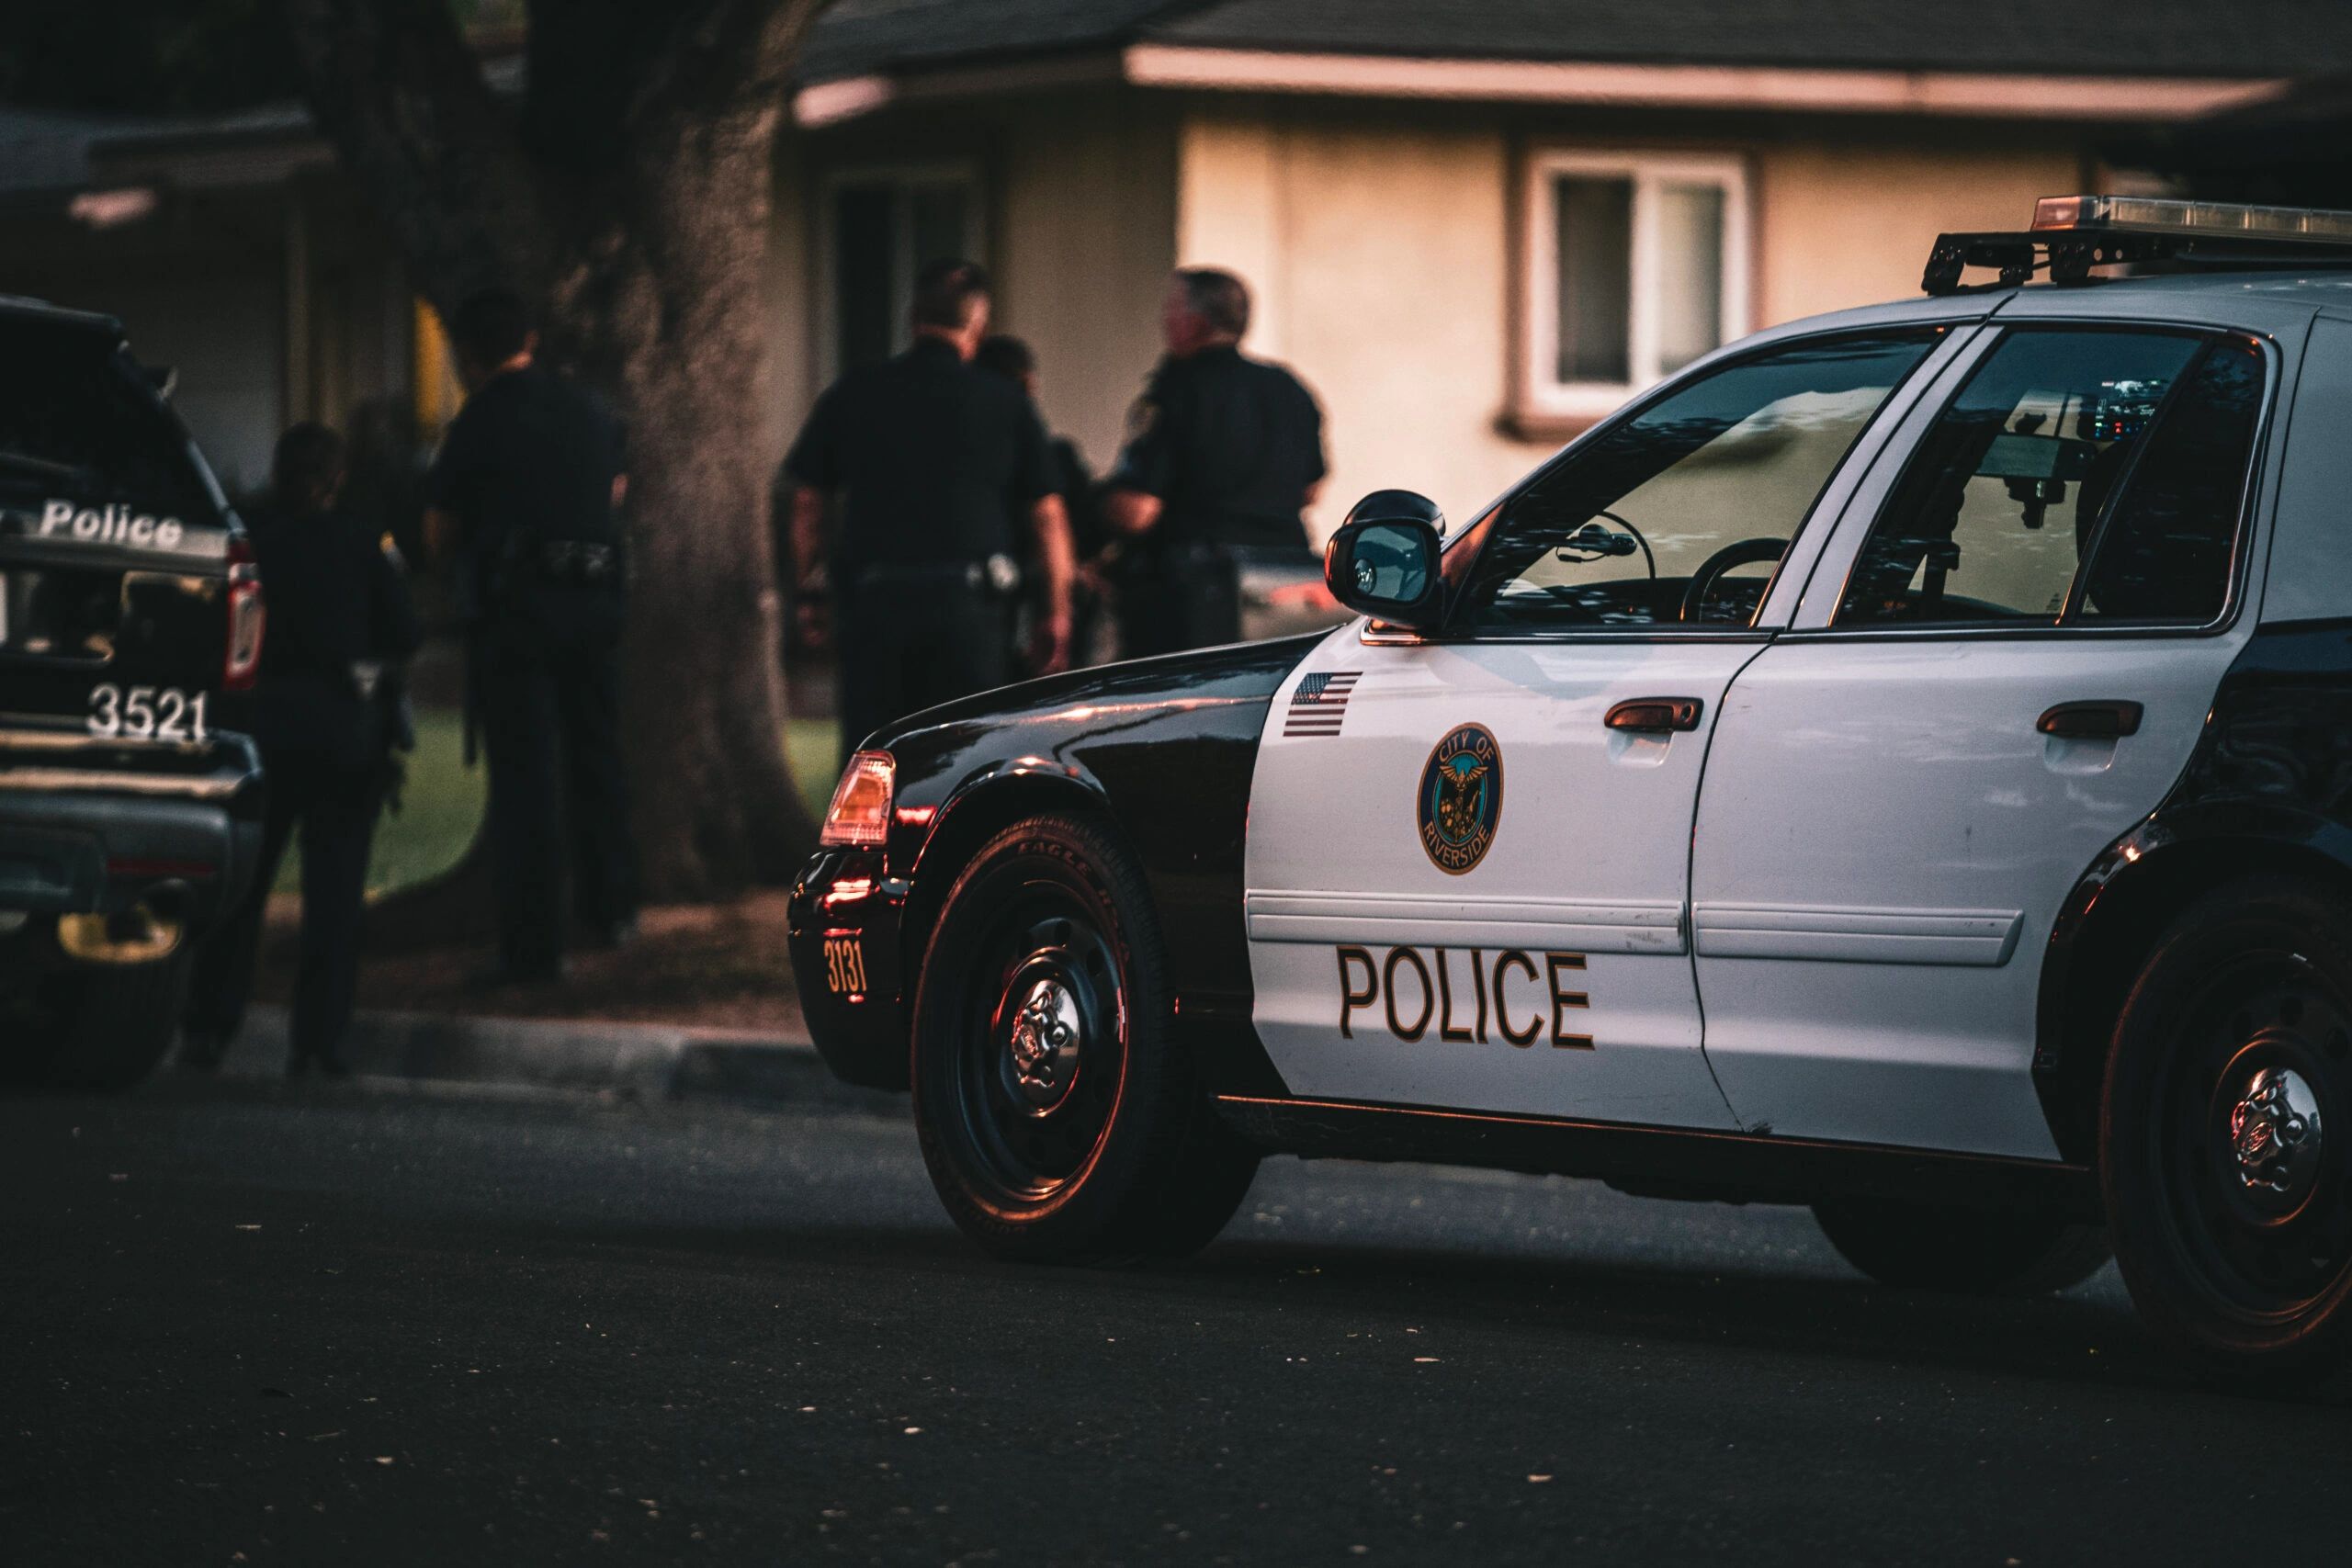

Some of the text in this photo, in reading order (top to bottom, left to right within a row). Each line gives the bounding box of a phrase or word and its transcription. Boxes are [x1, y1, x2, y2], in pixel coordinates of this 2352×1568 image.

[40, 498, 183, 551] Police
[86, 682, 209, 745] 3521
[1439, 731, 1495, 762] CITY OF
[1017, 841, 1091, 875] EAGLE
[1424, 821, 1490, 867] RIVERSIDE
[824, 940, 867, 992] 3131
[1337, 944, 1596, 1051] POLICE
